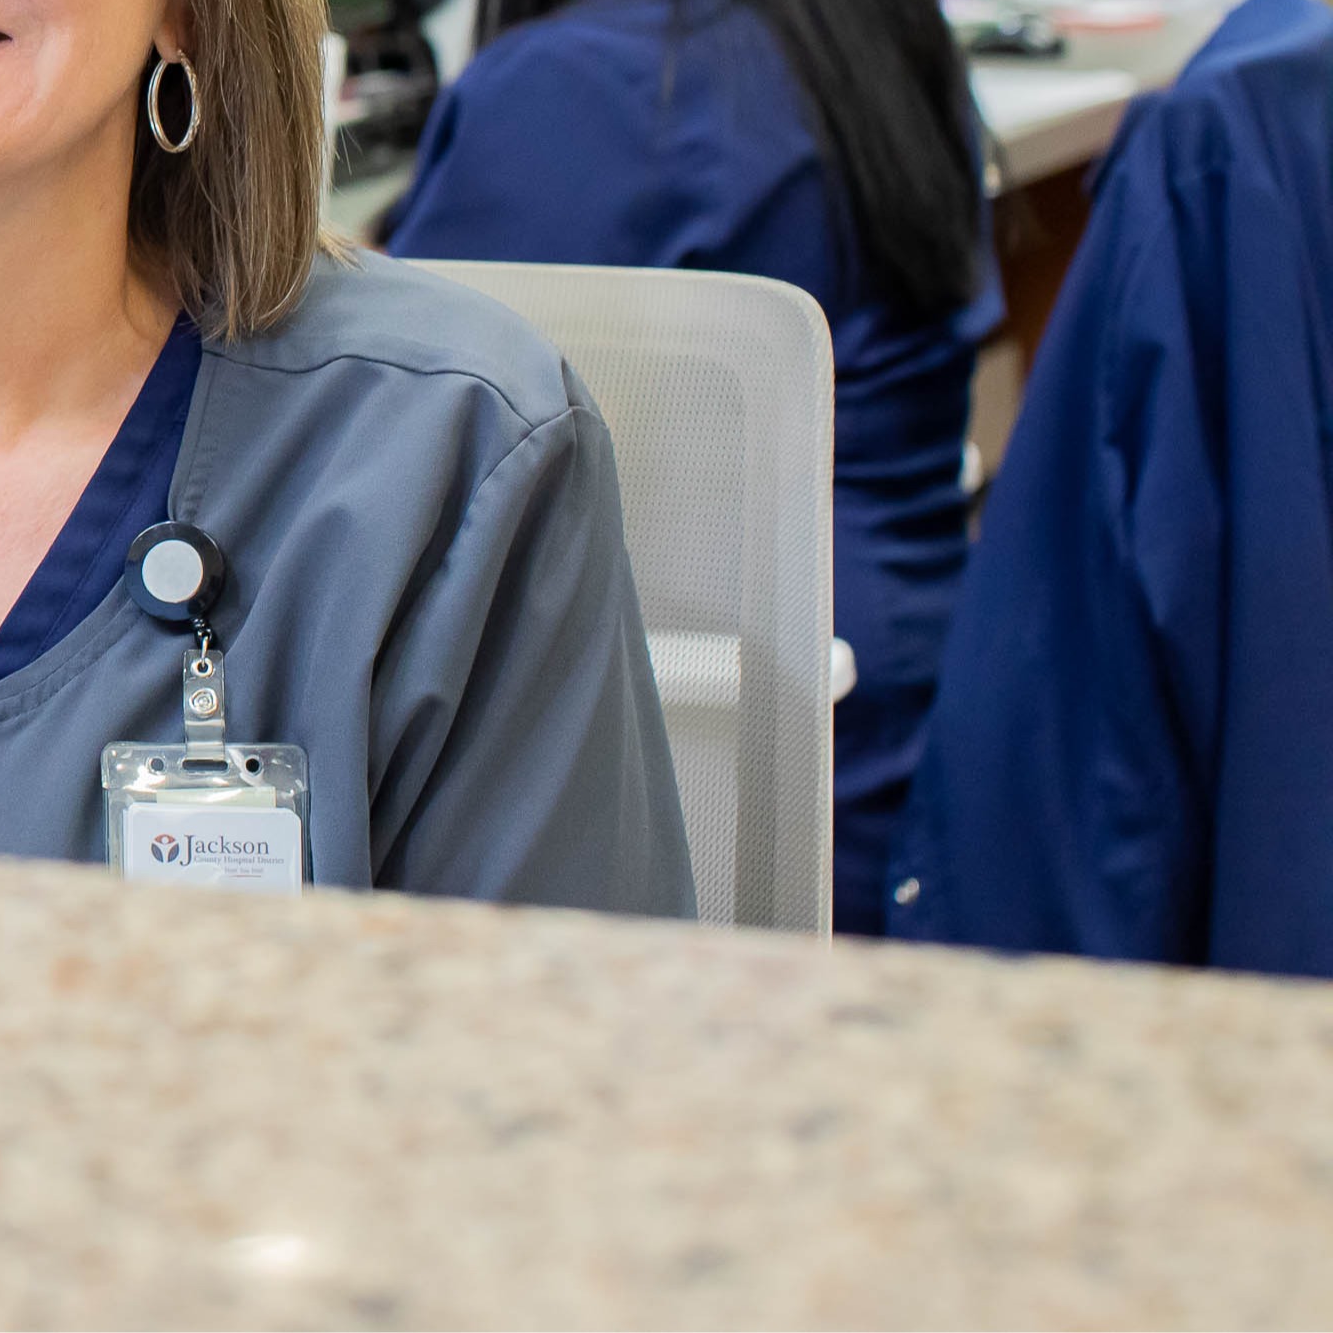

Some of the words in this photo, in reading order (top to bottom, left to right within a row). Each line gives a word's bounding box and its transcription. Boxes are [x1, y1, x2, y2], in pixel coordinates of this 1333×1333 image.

[179, 834, 269, 866] Jackson
[194, 856, 221, 865] County
[224, 856, 255, 865] Hospital
[257, 856, 285, 865] District
